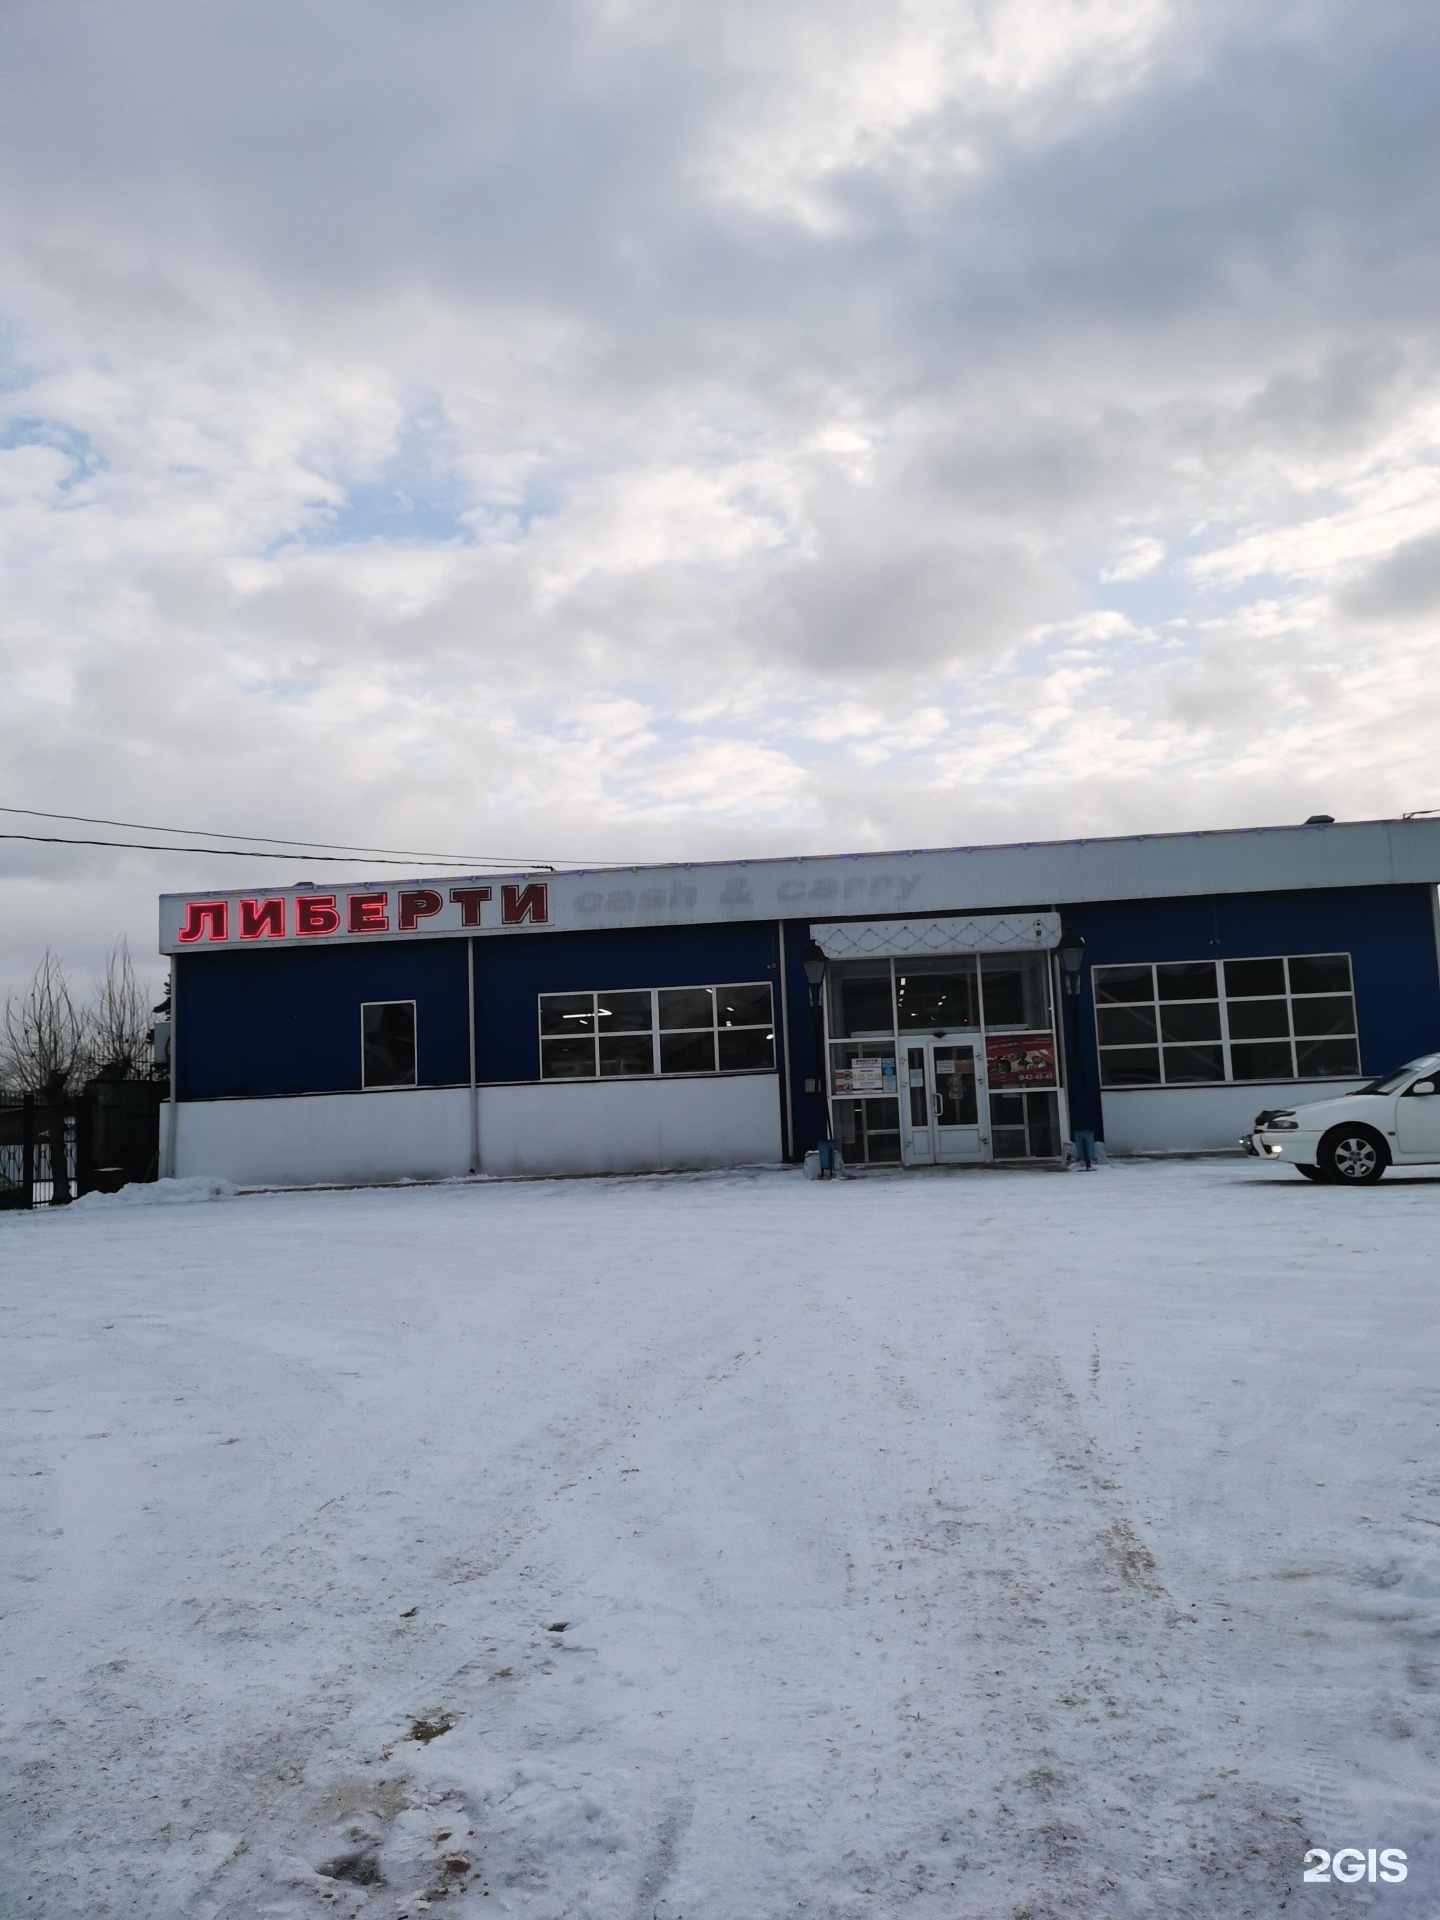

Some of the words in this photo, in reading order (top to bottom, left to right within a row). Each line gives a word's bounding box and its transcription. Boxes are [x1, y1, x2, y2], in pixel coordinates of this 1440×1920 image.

[179, 883, 548, 942] ЛИБЕРТИ
[573, 879, 698, 913] cash
[719, 876, 753, 904] &
[776, 872, 925, 902] carry
